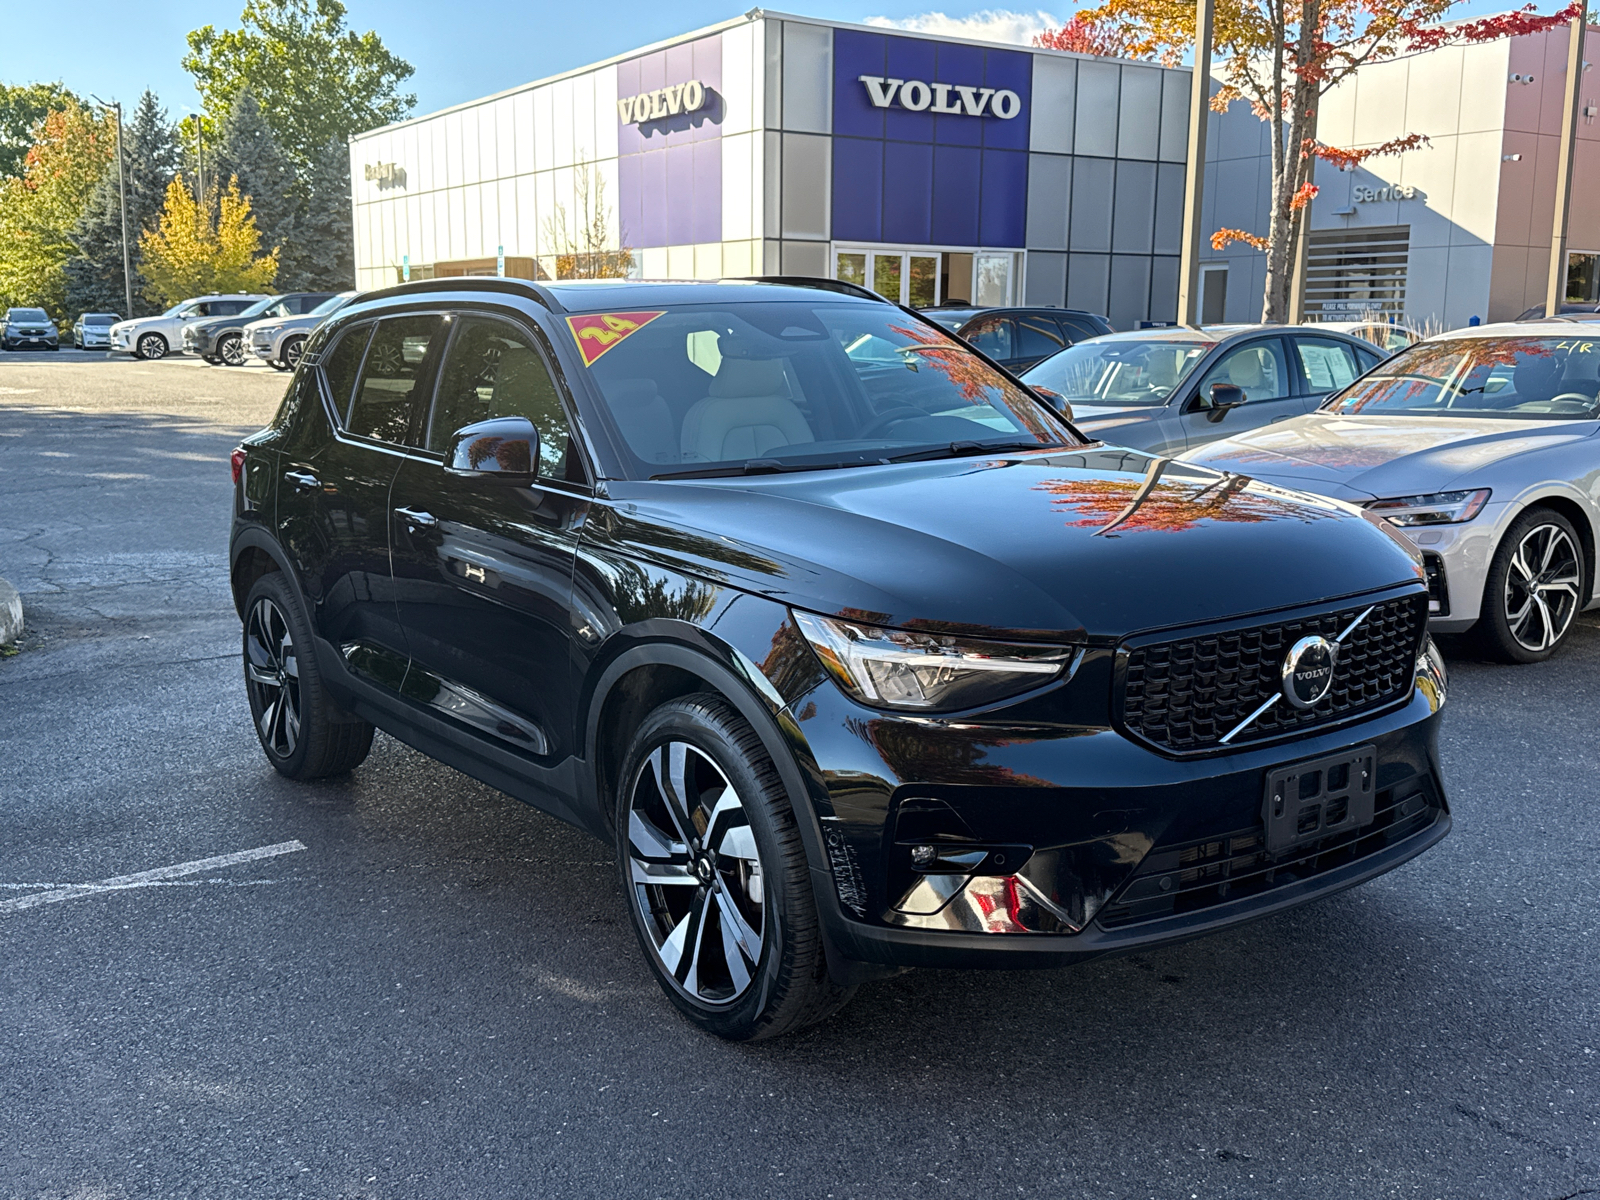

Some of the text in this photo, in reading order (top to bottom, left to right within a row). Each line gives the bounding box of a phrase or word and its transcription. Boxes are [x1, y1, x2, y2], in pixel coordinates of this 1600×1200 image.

[616, 80, 705, 125] VOLVO
[858, 75, 1021, 119] VOLVO
[1352, 184, 1415, 202] Service
[578, 315, 640, 345] 24
[1556, 340, 1593, 356] L/R
[1296, 667, 1330, 681] VOLVO
